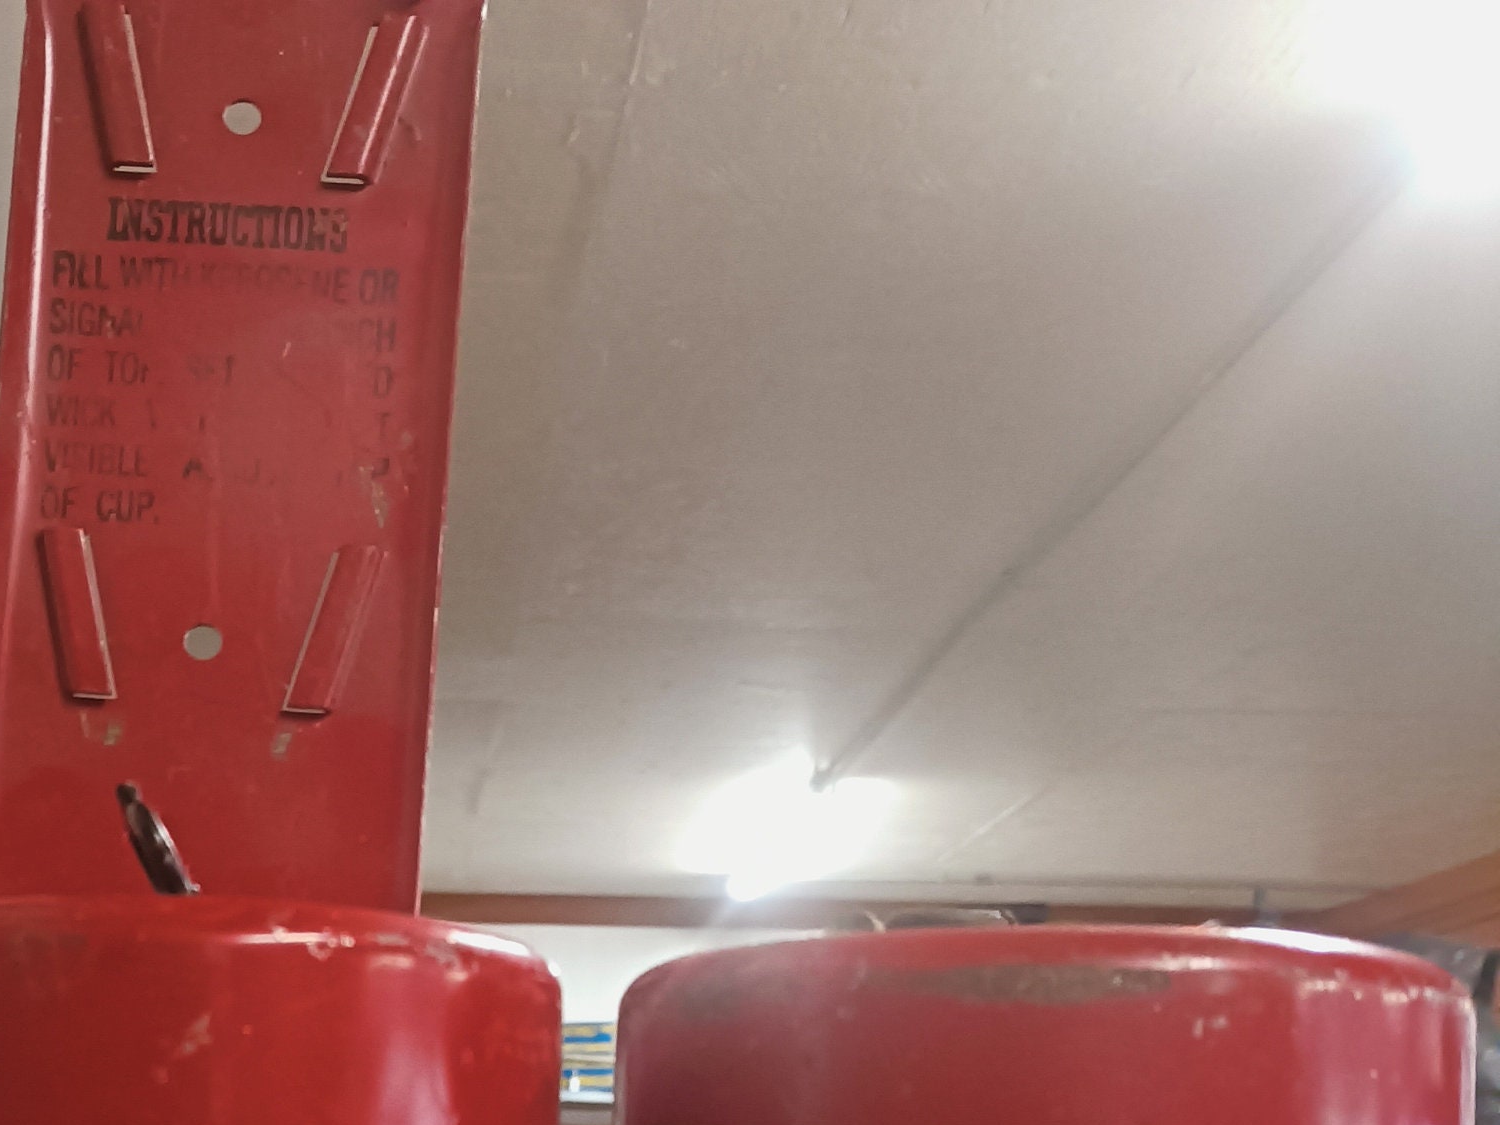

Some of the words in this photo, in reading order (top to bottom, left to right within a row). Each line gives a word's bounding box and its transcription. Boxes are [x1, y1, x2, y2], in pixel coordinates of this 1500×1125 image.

[107, 197, 349, 252] INSTRUCTIONS
[52, 250, 109, 291] FILL
[358, 266, 402, 304] OR
[48, 297, 144, 337] SIGNA
[46, 343, 84, 382] OF
[39, 482, 81, 520] OF
[95, 488, 161, 525] CUP.
